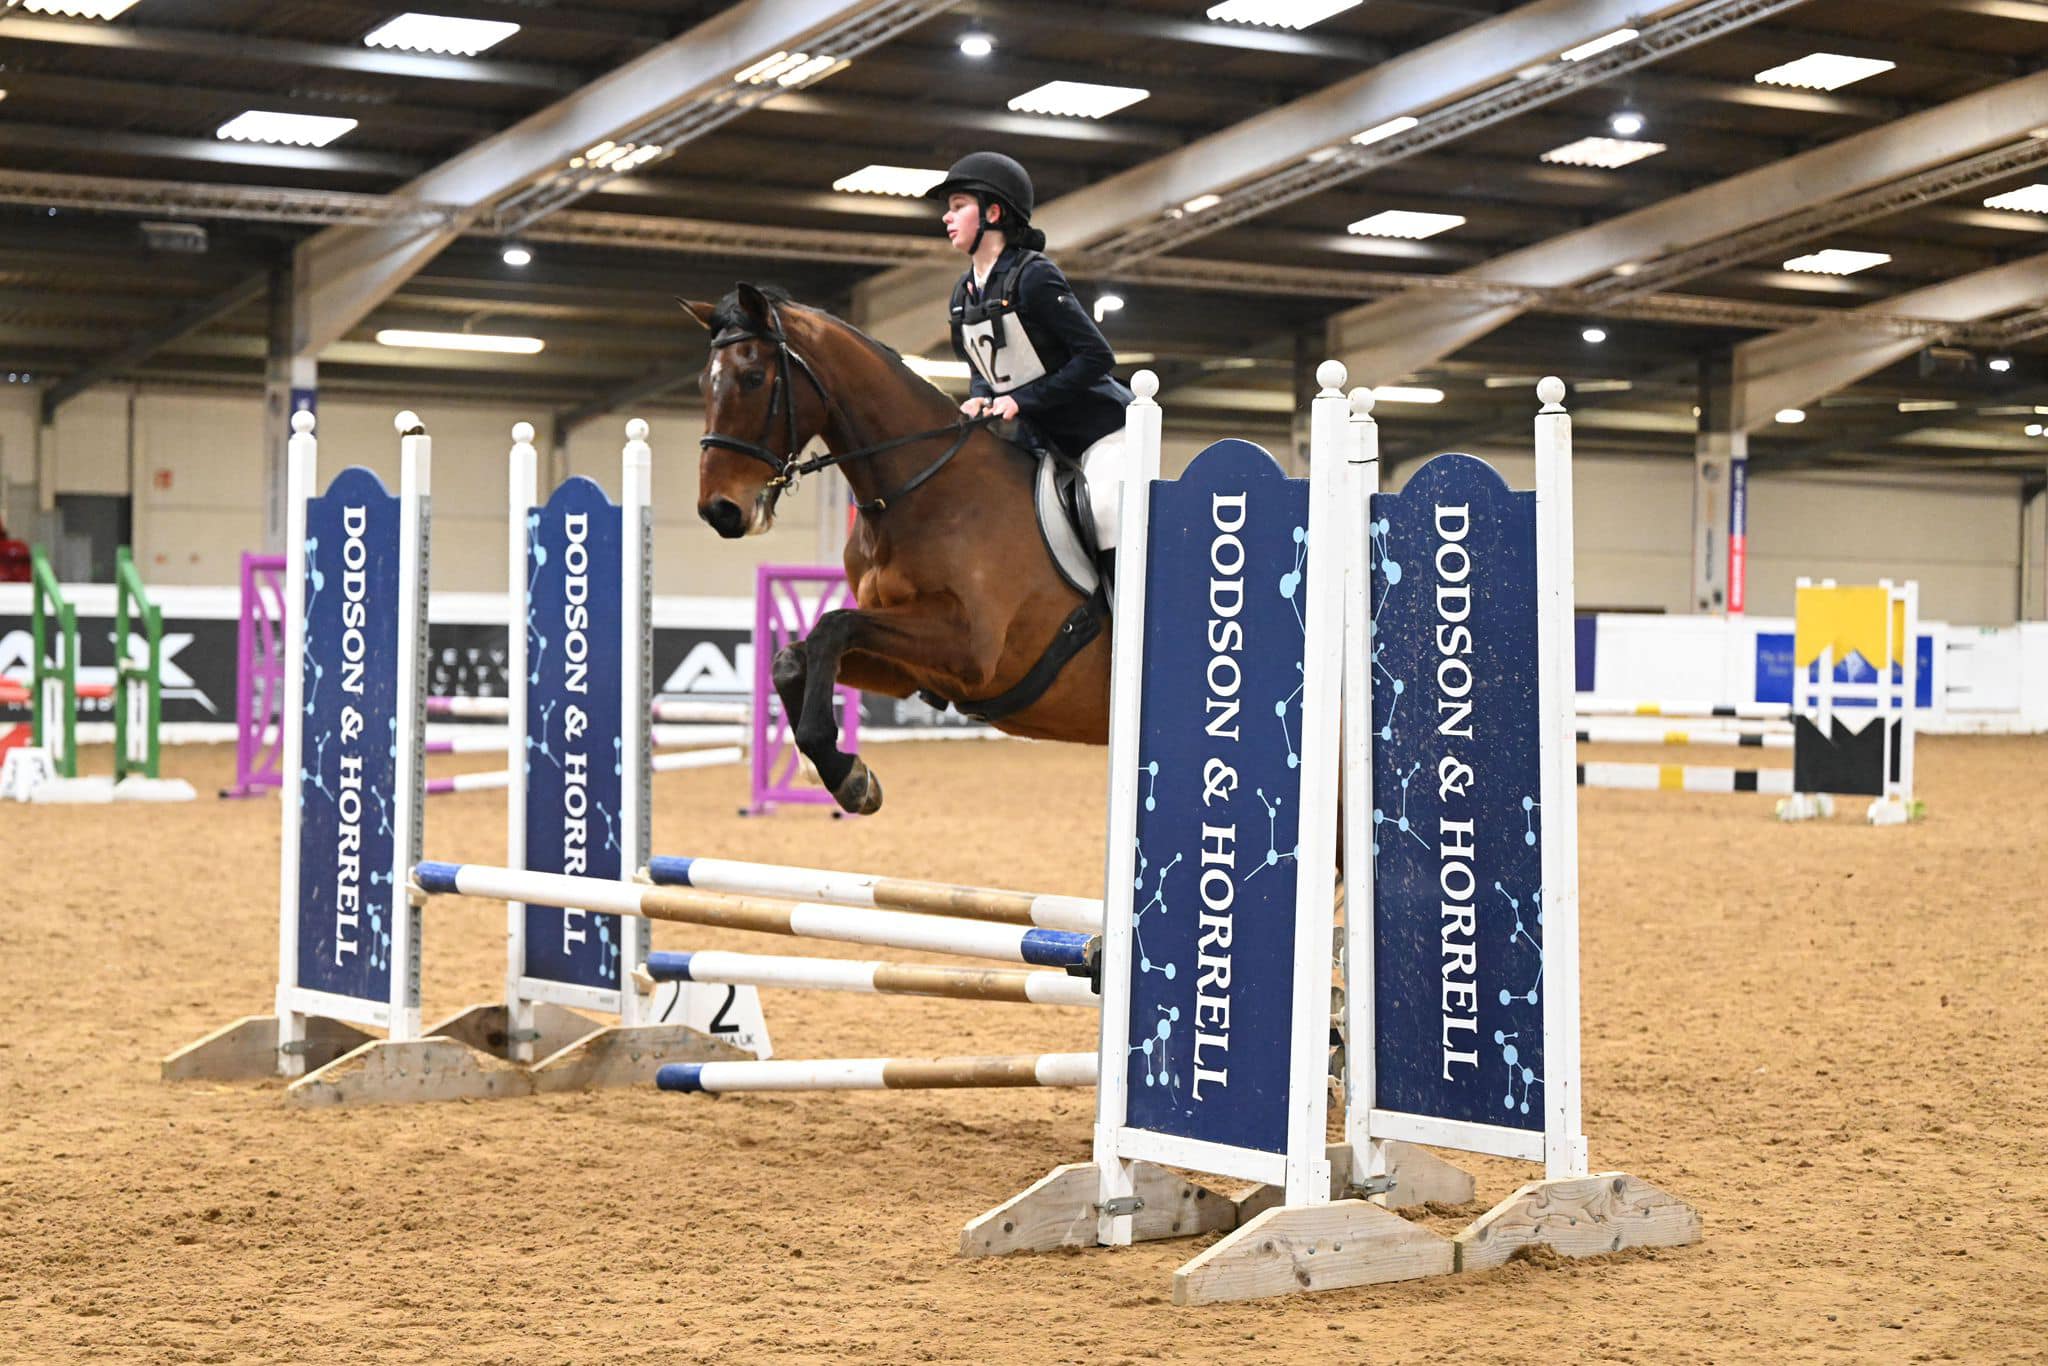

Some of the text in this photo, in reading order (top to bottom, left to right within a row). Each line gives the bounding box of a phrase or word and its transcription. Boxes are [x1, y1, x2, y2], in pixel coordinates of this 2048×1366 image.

[970, 334, 1011, 385] 12
[335, 505, 367, 968] DODSON & HORRELL
[564, 512, 589, 956] DODSON & HORRLL
[1192, 491, 1246, 1102] DODSON & HORRELL
[1435, 502, 1479, 1082] DODSON & HORRELL
[709, 984, 739, 1034] 2
